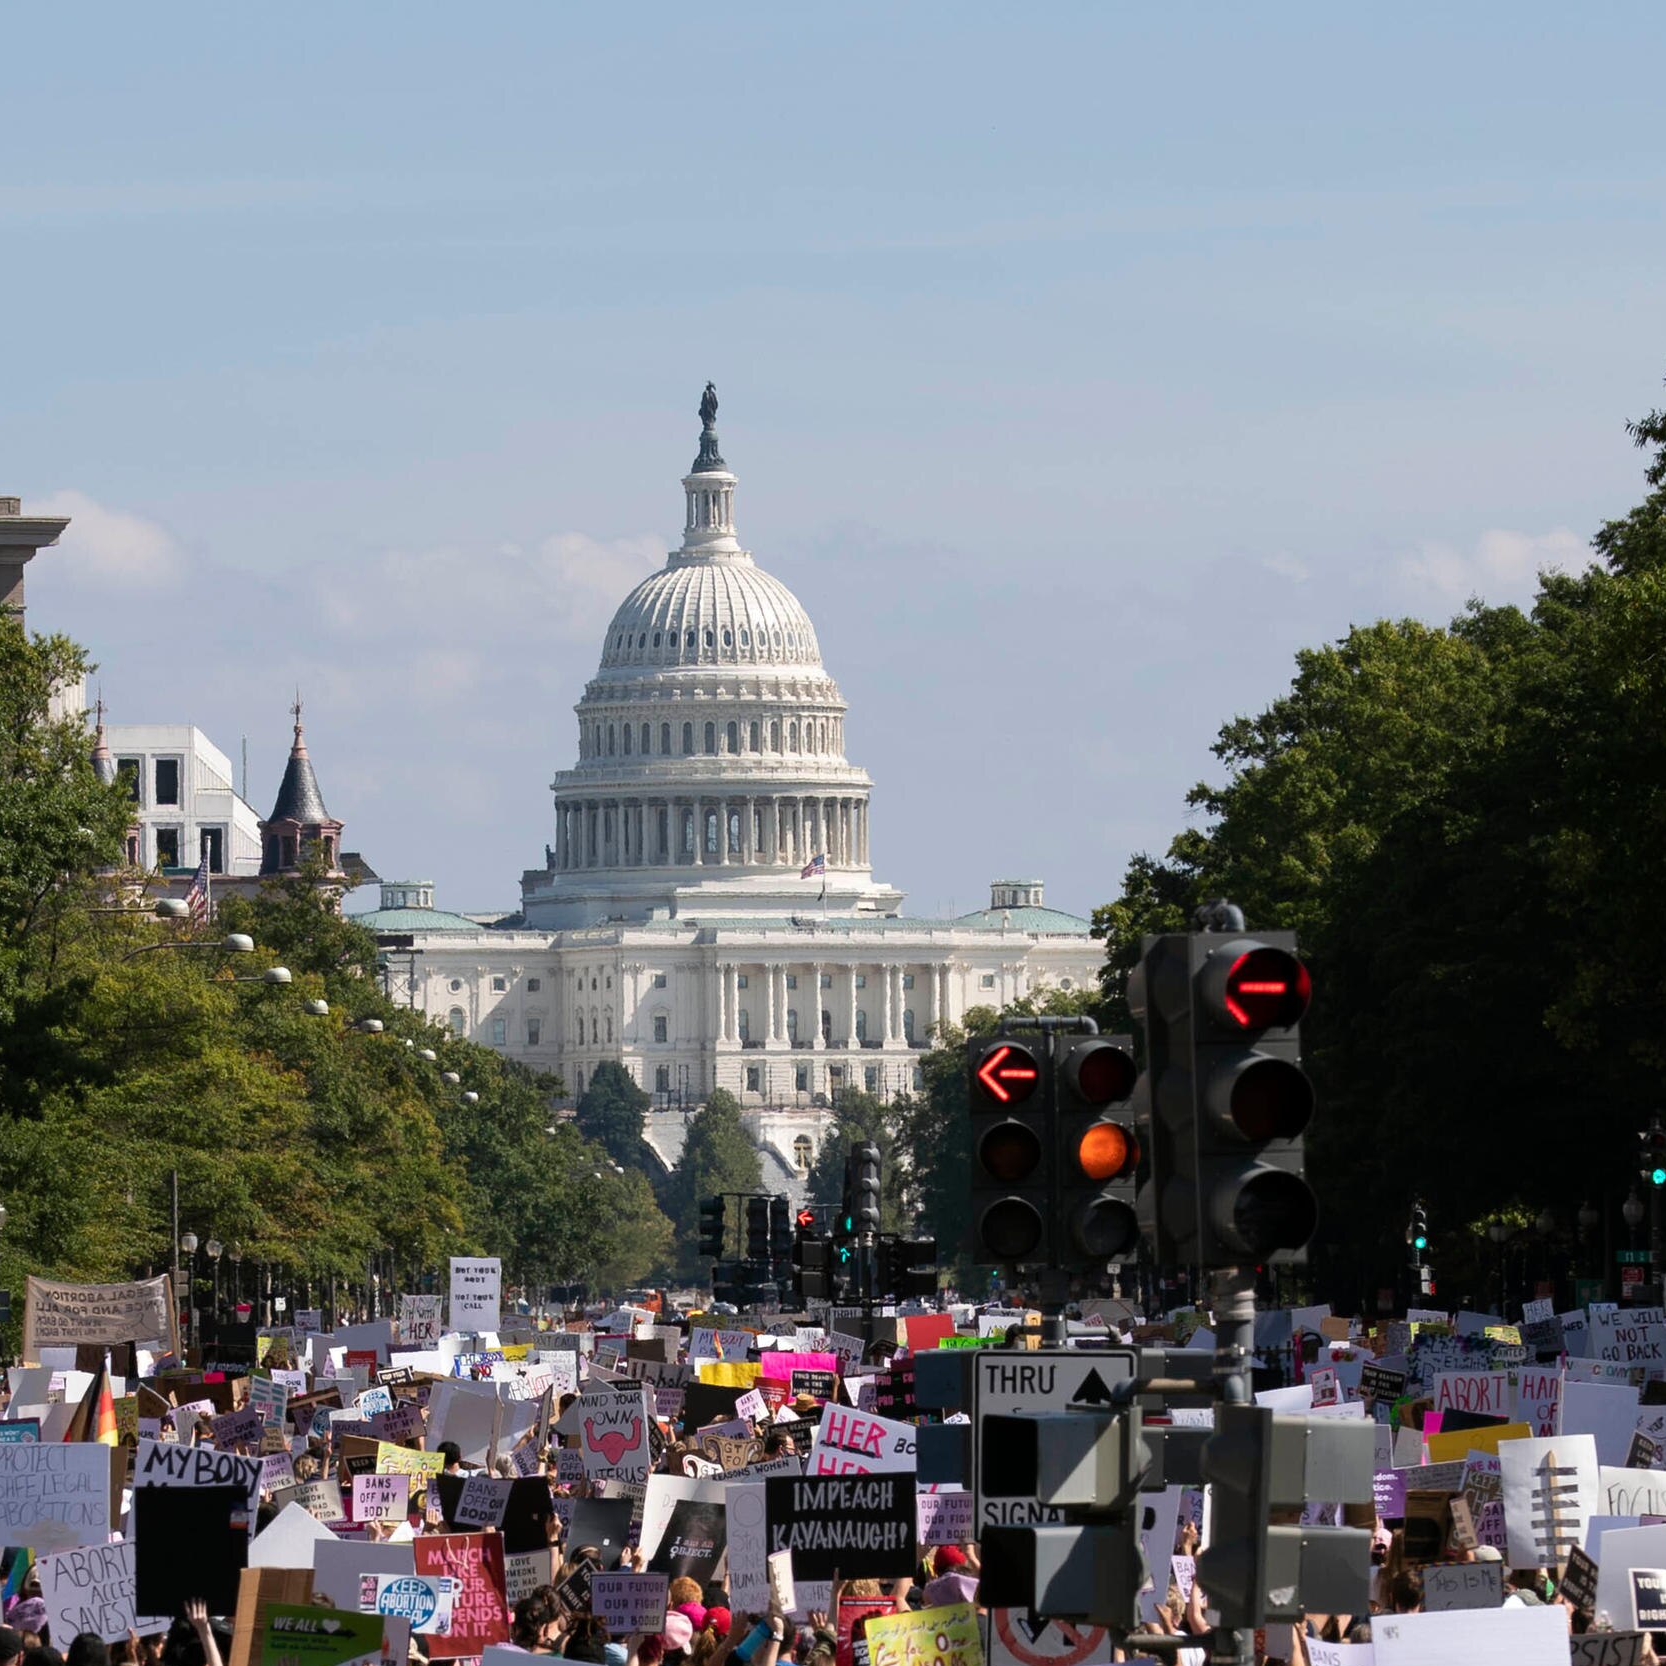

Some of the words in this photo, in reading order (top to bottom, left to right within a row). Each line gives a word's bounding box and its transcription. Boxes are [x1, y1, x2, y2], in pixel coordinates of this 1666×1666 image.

[463, 1302, 483, 1310] CALL
[1598, 1311, 1624, 1326] WE
[1630, 1309, 1663, 1325] WILL
[409, 1322, 433, 1339] HER
[1614, 1326, 1649, 1342] NOT
[1602, 1345, 1623, 1361] GO
[1626, 1342, 1662, 1361] BACK
[985, 1364, 1056, 1394] THRU
[578, 1394, 609, 1409] MIND
[612, 1392, 641, 1406] YOUR
[594, 1409, 633, 1426] OWN
[825, 1411, 887, 1457] HER
[143, 1443, 192, 1476] MY
[194, 1451, 264, 1486] BODY
[42, 1473, 102, 1496] LEGAL
[365, 1478, 392, 1488] BANS
[359, 1492, 378, 1503] OFF
[382, 1490, 397, 1502] MY
[793, 1481, 894, 1511] IMPEACH
[364, 1505, 390, 1518] BODY
[772, 1521, 909, 1552] KAVANAUGH!
[390, 1578, 428, 1593] KEEP
[381, 1594, 435, 1612] ABORTION
[274, 1617, 295, 1631] WE
[297, 1619, 318, 1632] ALL
